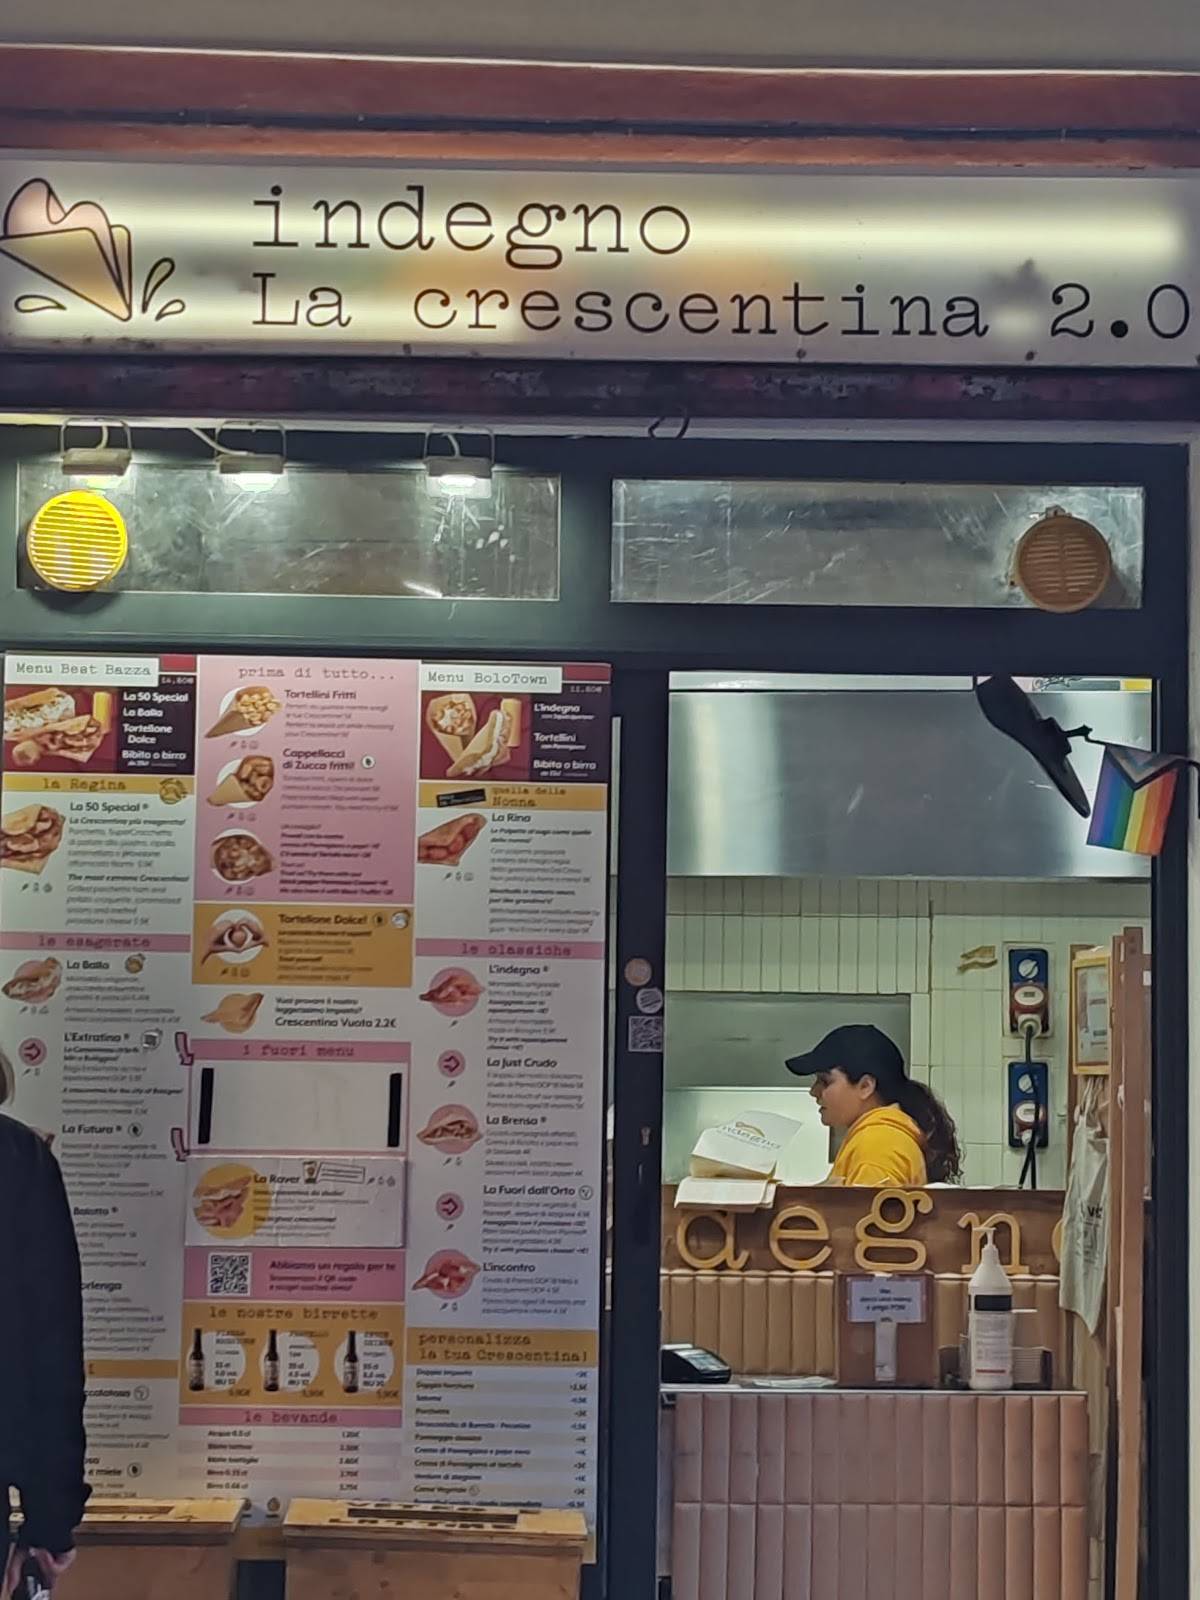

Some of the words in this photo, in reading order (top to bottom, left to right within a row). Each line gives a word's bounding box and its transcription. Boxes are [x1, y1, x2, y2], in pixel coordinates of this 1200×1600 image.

[251, 185, 690, 269] indegno
[252, 272, 351, 328] La
[414, 282, 989, 338] crescentina
[1050, 283, 1190, 339] 2.0
[16, 663, 53, 674] Menu
[105, 664, 151, 676] Bazza
[239, 666, 285, 679] prima
[294, 666, 311, 678] di
[428, 672, 465, 683] Menu
[474, 673, 548, 685] BoloTown
[123, 692, 137, 701] La
[138, 692, 150, 701] 50
[150, 692, 188, 703] Special
[284, 689, 330, 700] Tortellini
[332, 690, 357, 700] Fritti
[533, 732, 577, 743] Tortellini
[282, 749, 345, 760] Cappellacci
[282, 760, 293, 770] di
[295, 761, 327, 770] Zucca
[43, 778, 60, 789] la
[70, 778, 126, 791] Regina
[70, 802, 83, 811] La
[85, 802, 99, 811] 50
[101, 803, 140, 814] Special
[491, 813, 505, 823] La
[507, 813, 532, 823] Rina
[38, 935, 56, 946] le
[462, 943, 479, 954] le
[488, 944, 572, 956] classiche
[66, 961, 80, 969] La
[275, 1016, 338, 1027] Crescentina
[487, 1058, 501, 1067] La
[502, 1058, 522, 1069] Just
[524, 1058, 557, 1068] Crudo
[486, 1115, 500, 1125] La
[62, 1124, 76, 1134] La
[77, 1124, 114, 1134] Futura
[254, 1174, 267, 1183] La
[483, 1185, 498, 1195] La
[499, 1185, 526, 1195] Fuori
[482, 1262, 536, 1273] L'incontro
[209, 1306, 227, 1318] le
[303, 1307, 379, 1320] birrette
[419, 1350, 437, 1361] la
[245, 1412, 262, 1422] le
[272, 1412, 338, 1424] bevande
